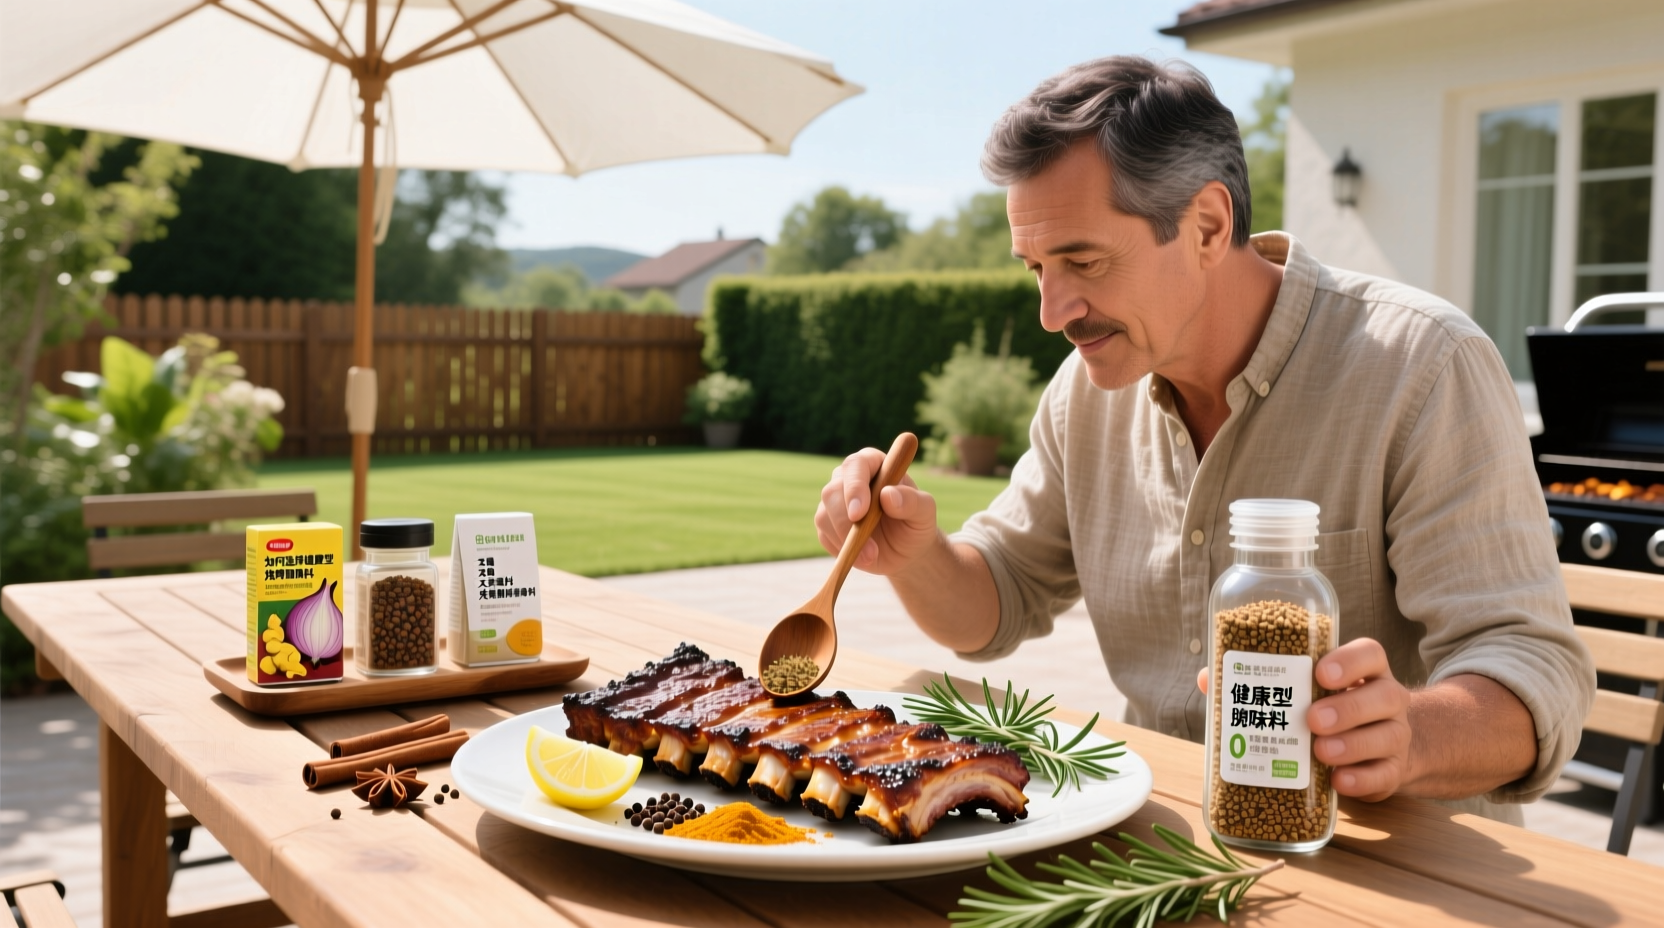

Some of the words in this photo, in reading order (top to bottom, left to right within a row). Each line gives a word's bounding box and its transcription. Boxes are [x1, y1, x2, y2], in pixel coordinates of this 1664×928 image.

[1230, 682, 1293, 707] 健康型
[1229, 733, 1247, 759] 0
